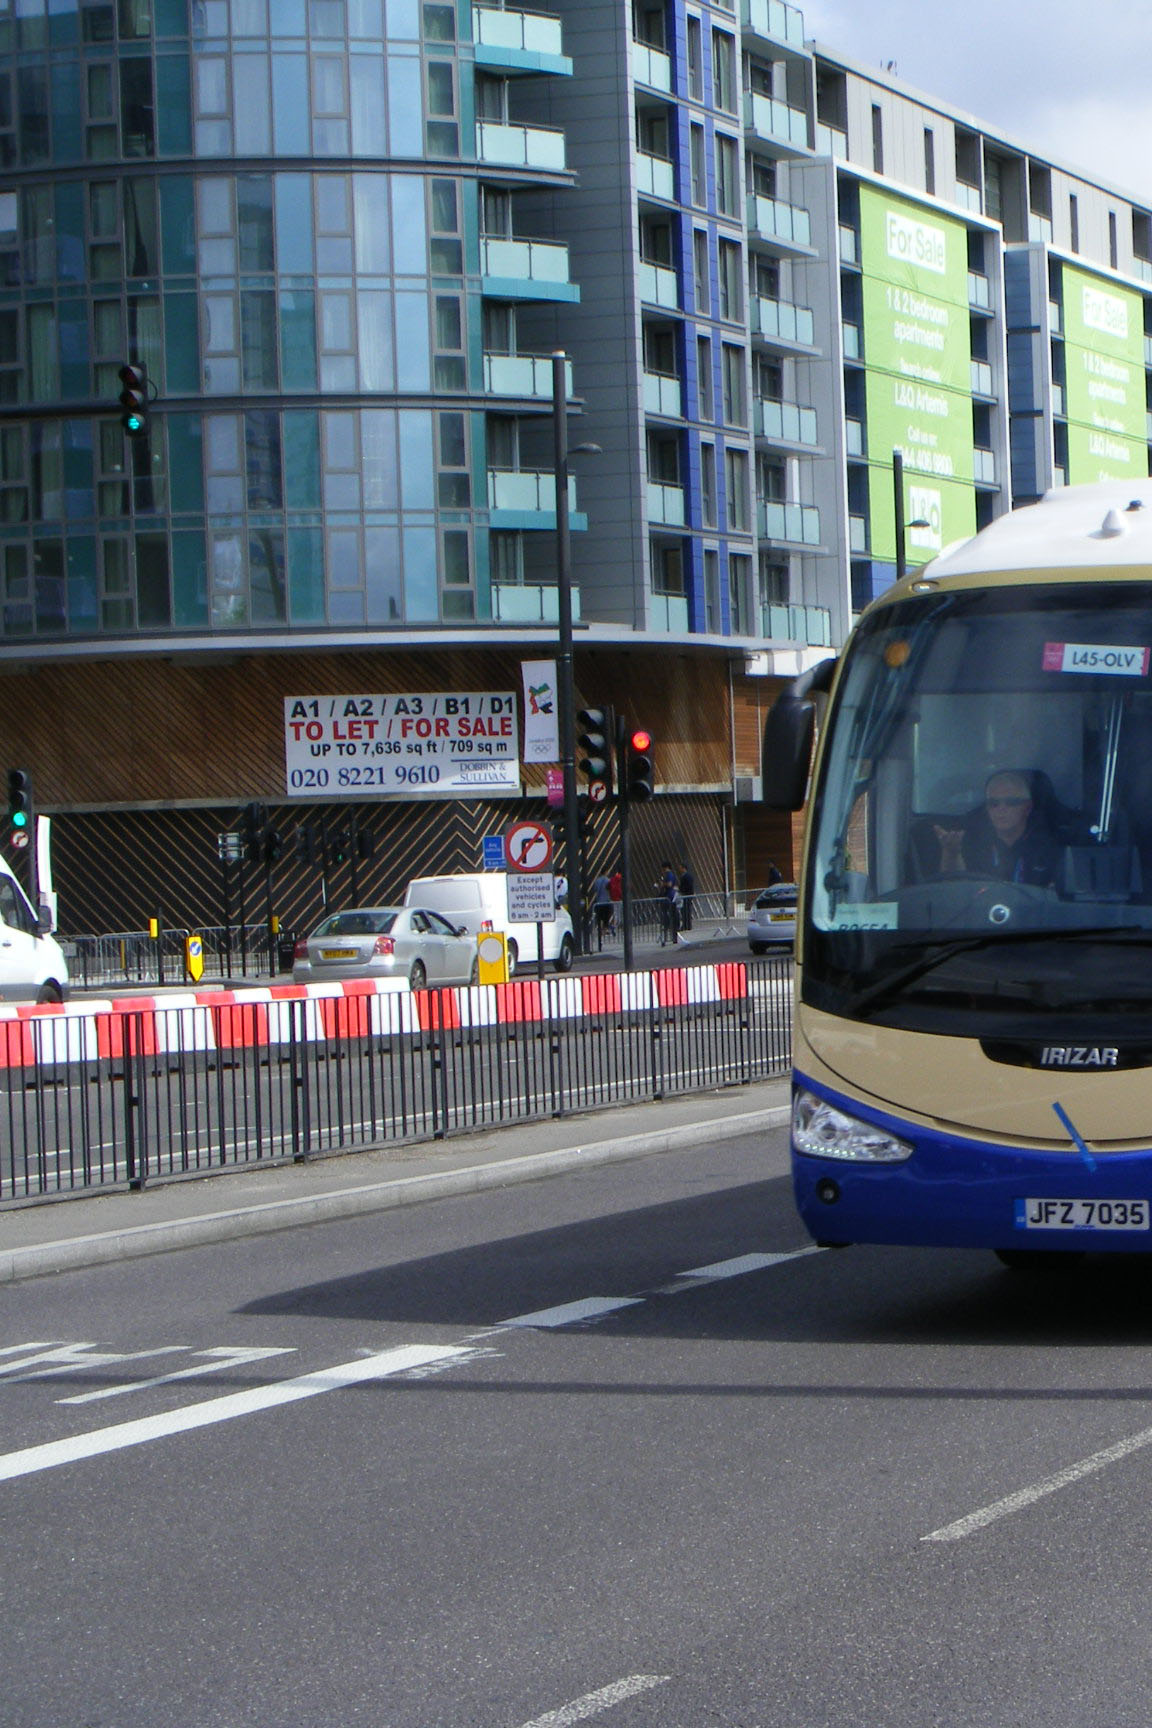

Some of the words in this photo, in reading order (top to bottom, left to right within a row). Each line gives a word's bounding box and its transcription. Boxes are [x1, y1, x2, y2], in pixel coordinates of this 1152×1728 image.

[888, 218, 913, 254] For
[915, 228, 945, 267] Sale
[1072, 651, 1135, 667] L45-OLV
[291, 700, 319, 718] A1
[330, 700, 335, 717] /
[343, 699, 373, 717] A2
[381, 699, 386, 716] /
[394, 698, 423, 715] A3
[432, 699, 437, 716] /
[445, 697, 469, 715] B1
[479, 697, 483, 714] /
[490, 697, 513, 714] D1
[289, 721, 323, 741] TO
[333, 720, 379, 740] LET
[387, 719, 392, 738] /
[401, 717, 450, 738] FOR
[458, 717, 513, 737] SALE
[311, 744, 331, 756] UP
[336, 743, 356, 756] TO
[362, 741, 401, 757] 7,636
[406, 743, 422, 756] sq
[426, 741, 437, 752] ft
[449, 740, 473, 752] 709
[477, 742, 492, 755] sq
[496, 742, 507, 751] m
[291, 768, 329, 788] 020
[338, 766, 385, 786] 8221
[395, 765, 440, 784] 9610
[460, 773, 506, 781] SULLIVAN
[517, 876, 543, 884] Except
[527, 901, 551, 909] cycles
[1041, 1047, 1118, 1065] IRIZAR
[1030, 1202, 1074, 1224] JFZ
[1081, 1203, 1144, 1225] 7035
